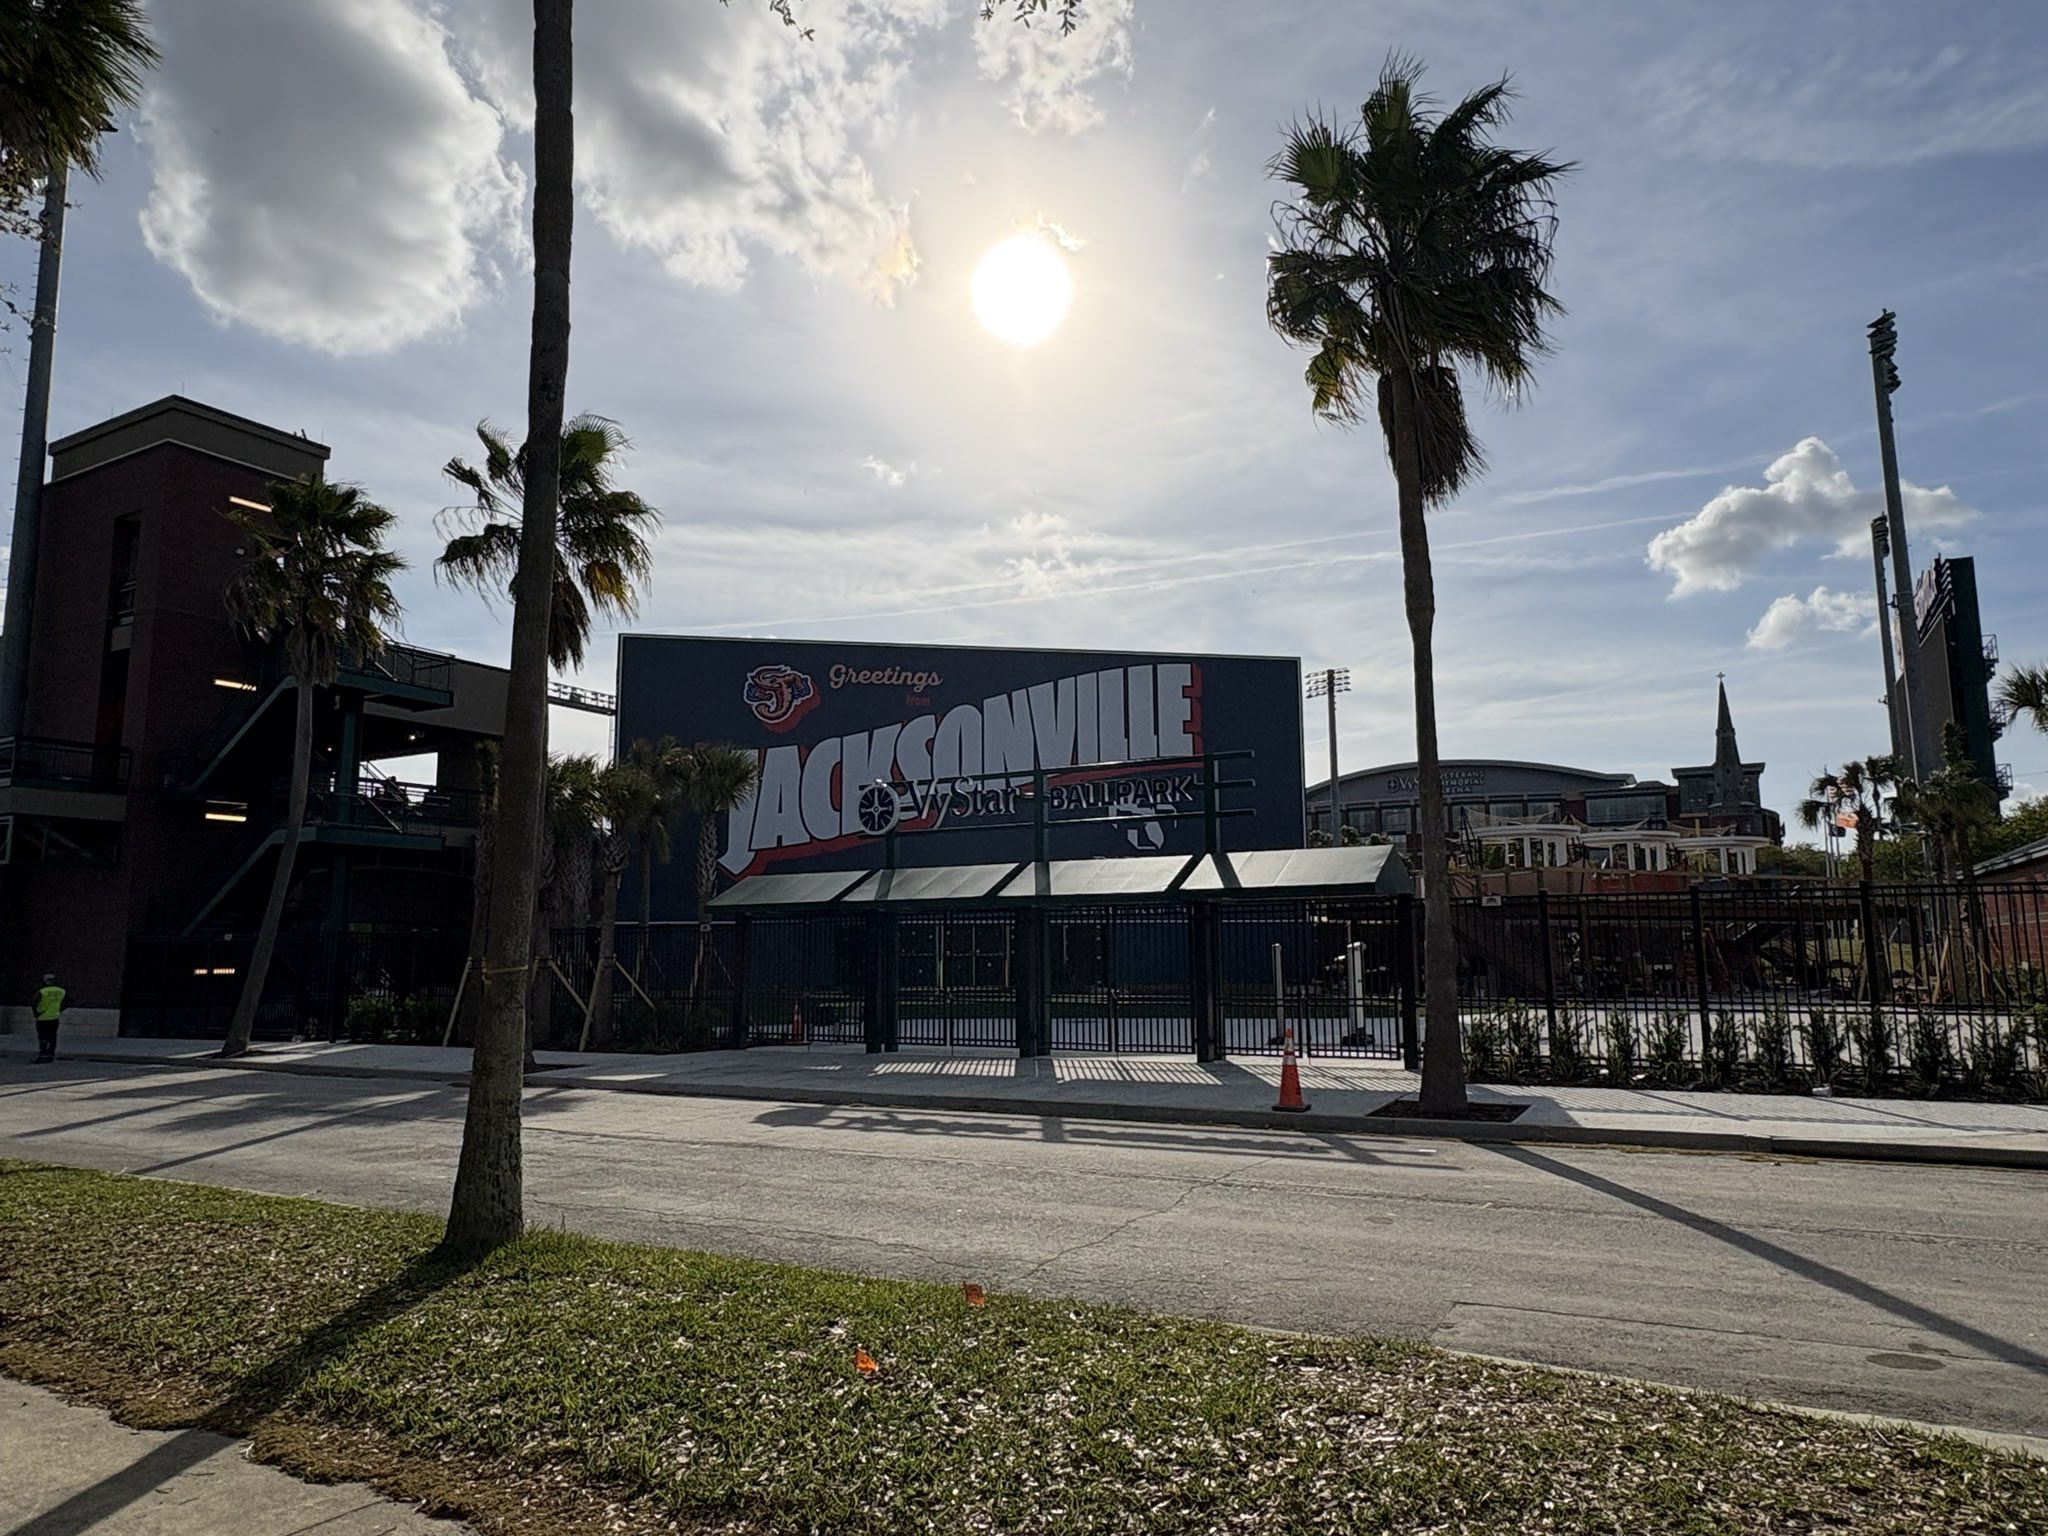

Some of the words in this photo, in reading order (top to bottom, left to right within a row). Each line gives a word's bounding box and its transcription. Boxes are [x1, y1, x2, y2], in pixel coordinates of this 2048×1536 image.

[829, 664, 943, 693] Greetings
[907, 694, 931, 707] from
[717, 664, 1196, 875] JACKSONVILLE
[909, 776, 1021, 829] VyStar
[1050, 776, 1194, 809] BALLPARK
